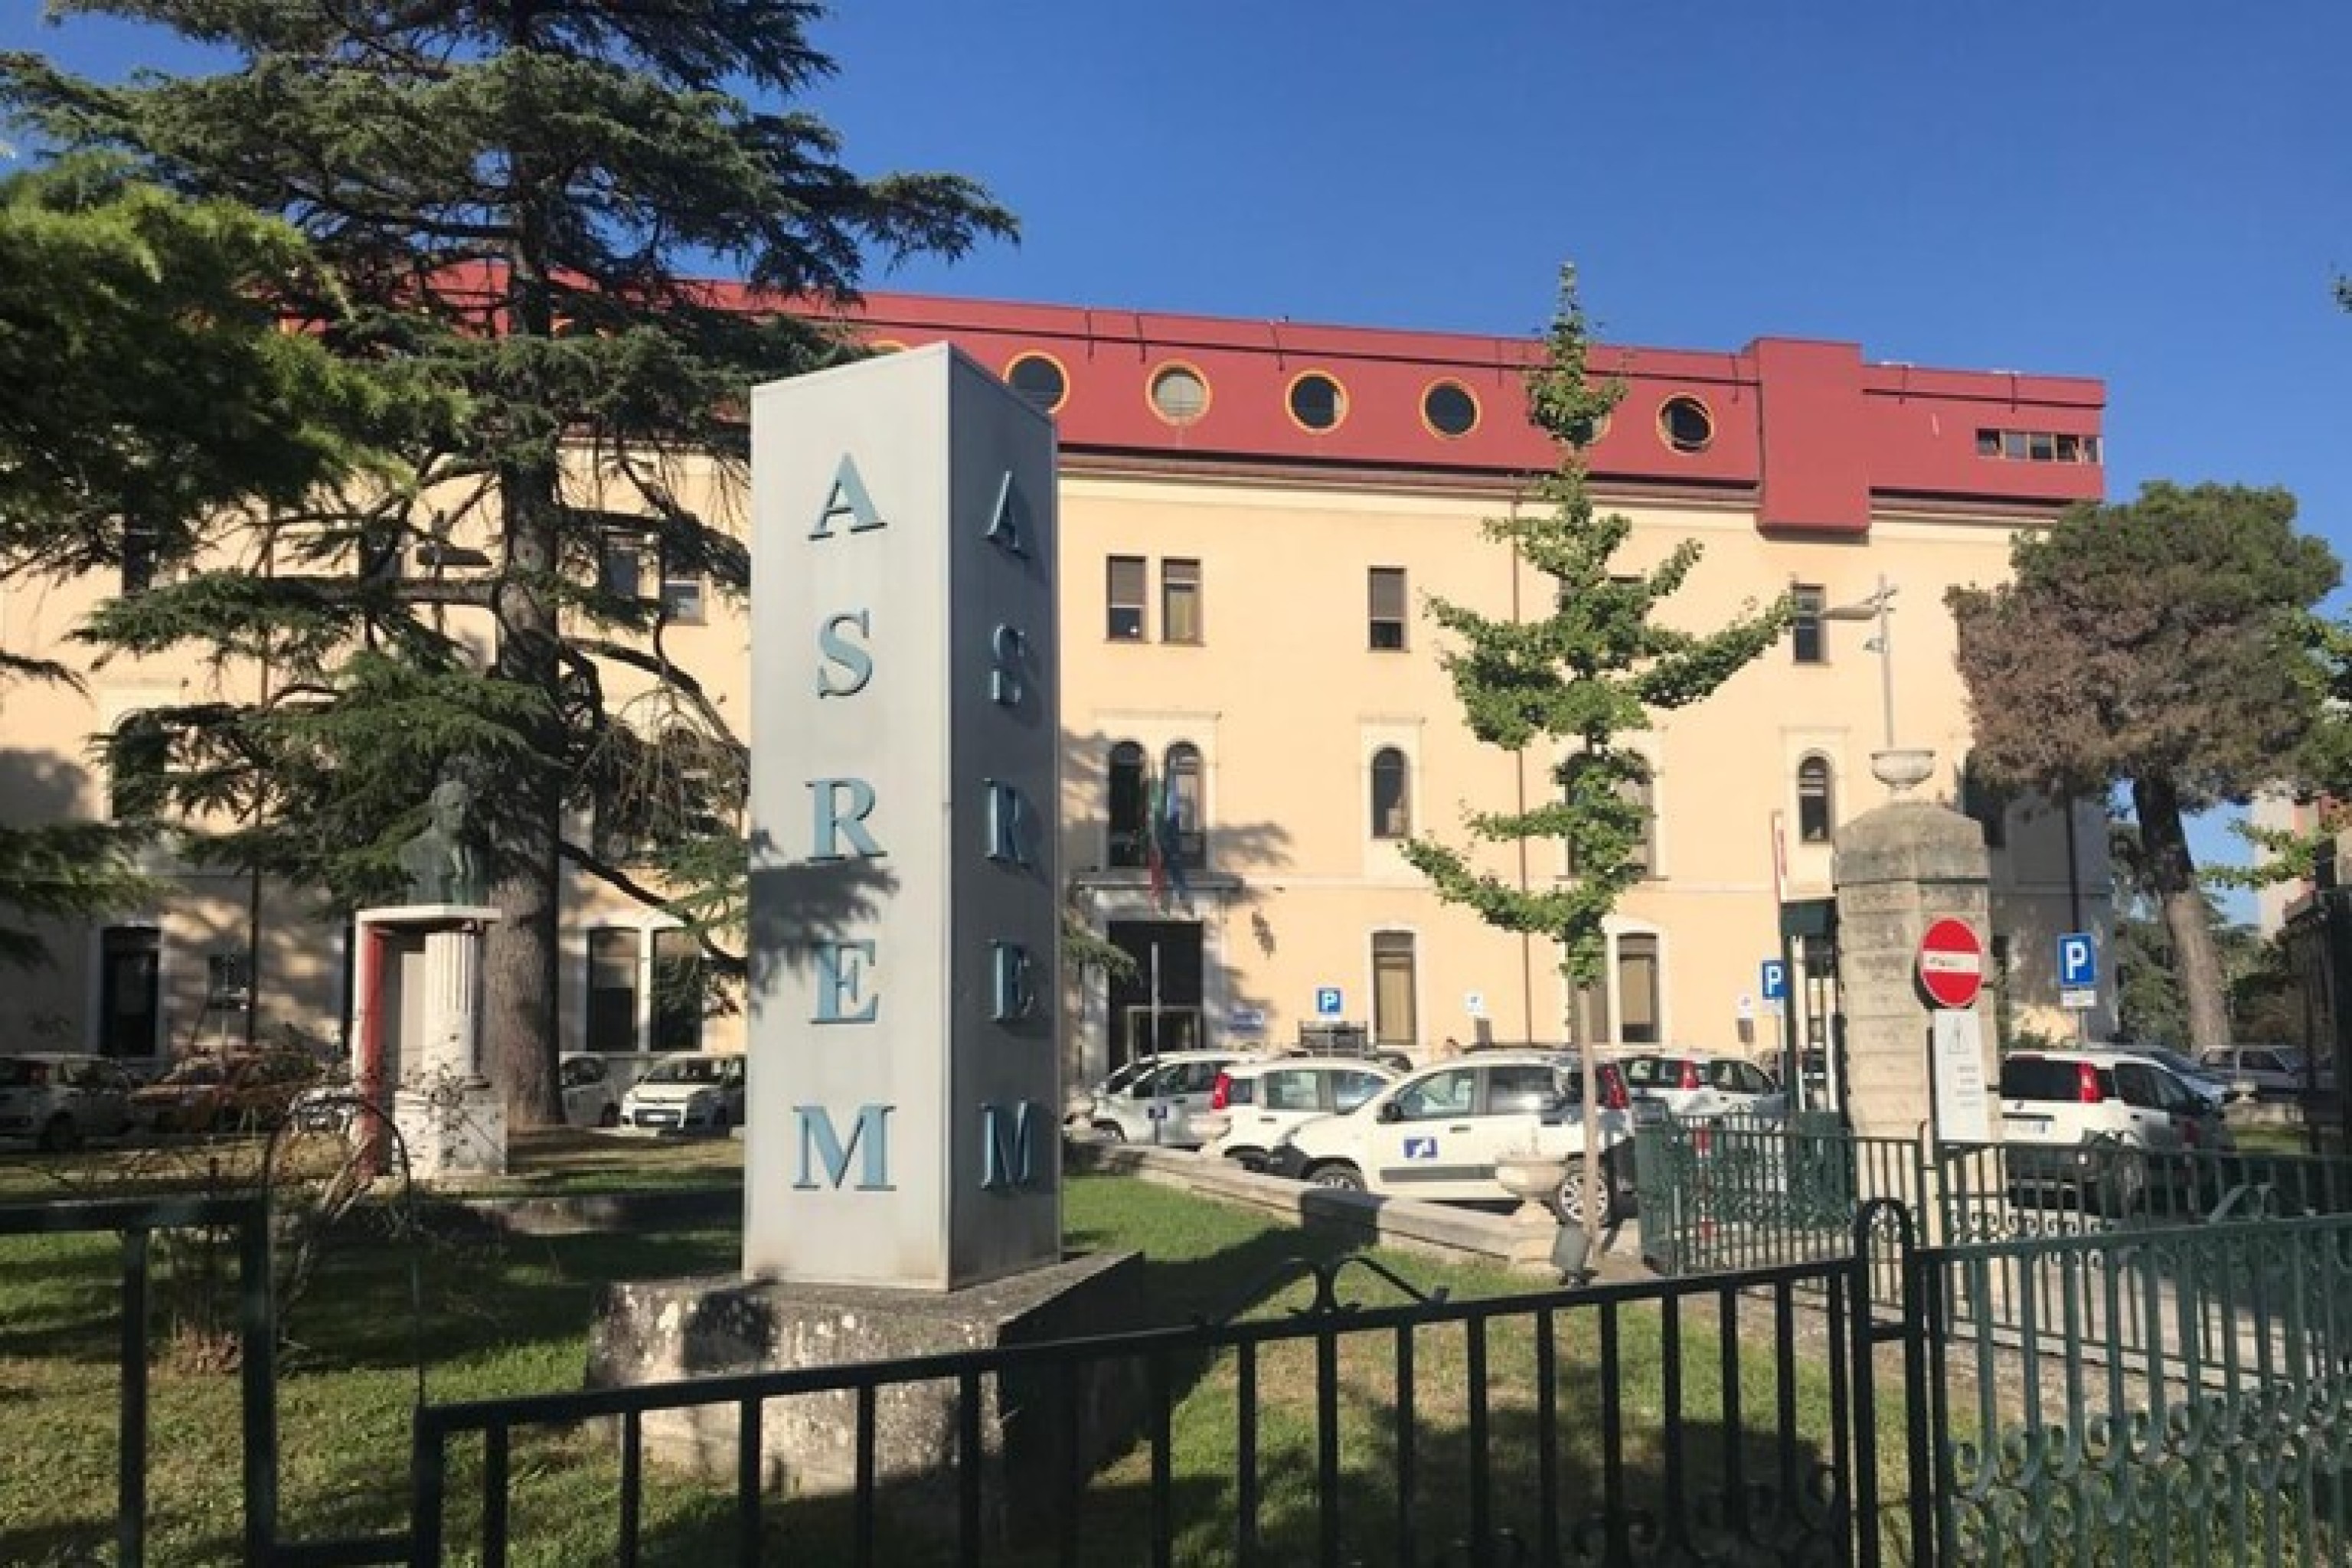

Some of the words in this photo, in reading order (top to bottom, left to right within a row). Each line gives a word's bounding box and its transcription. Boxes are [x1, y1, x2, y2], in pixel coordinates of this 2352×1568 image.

[793, 452, 897, 1191] ASREM
[981, 470, 1034, 1192] ASREM
[2066, 941, 2088, 979] P
[1766, 965, 1782, 995] P
[1321, 993, 1338, 1010] P
